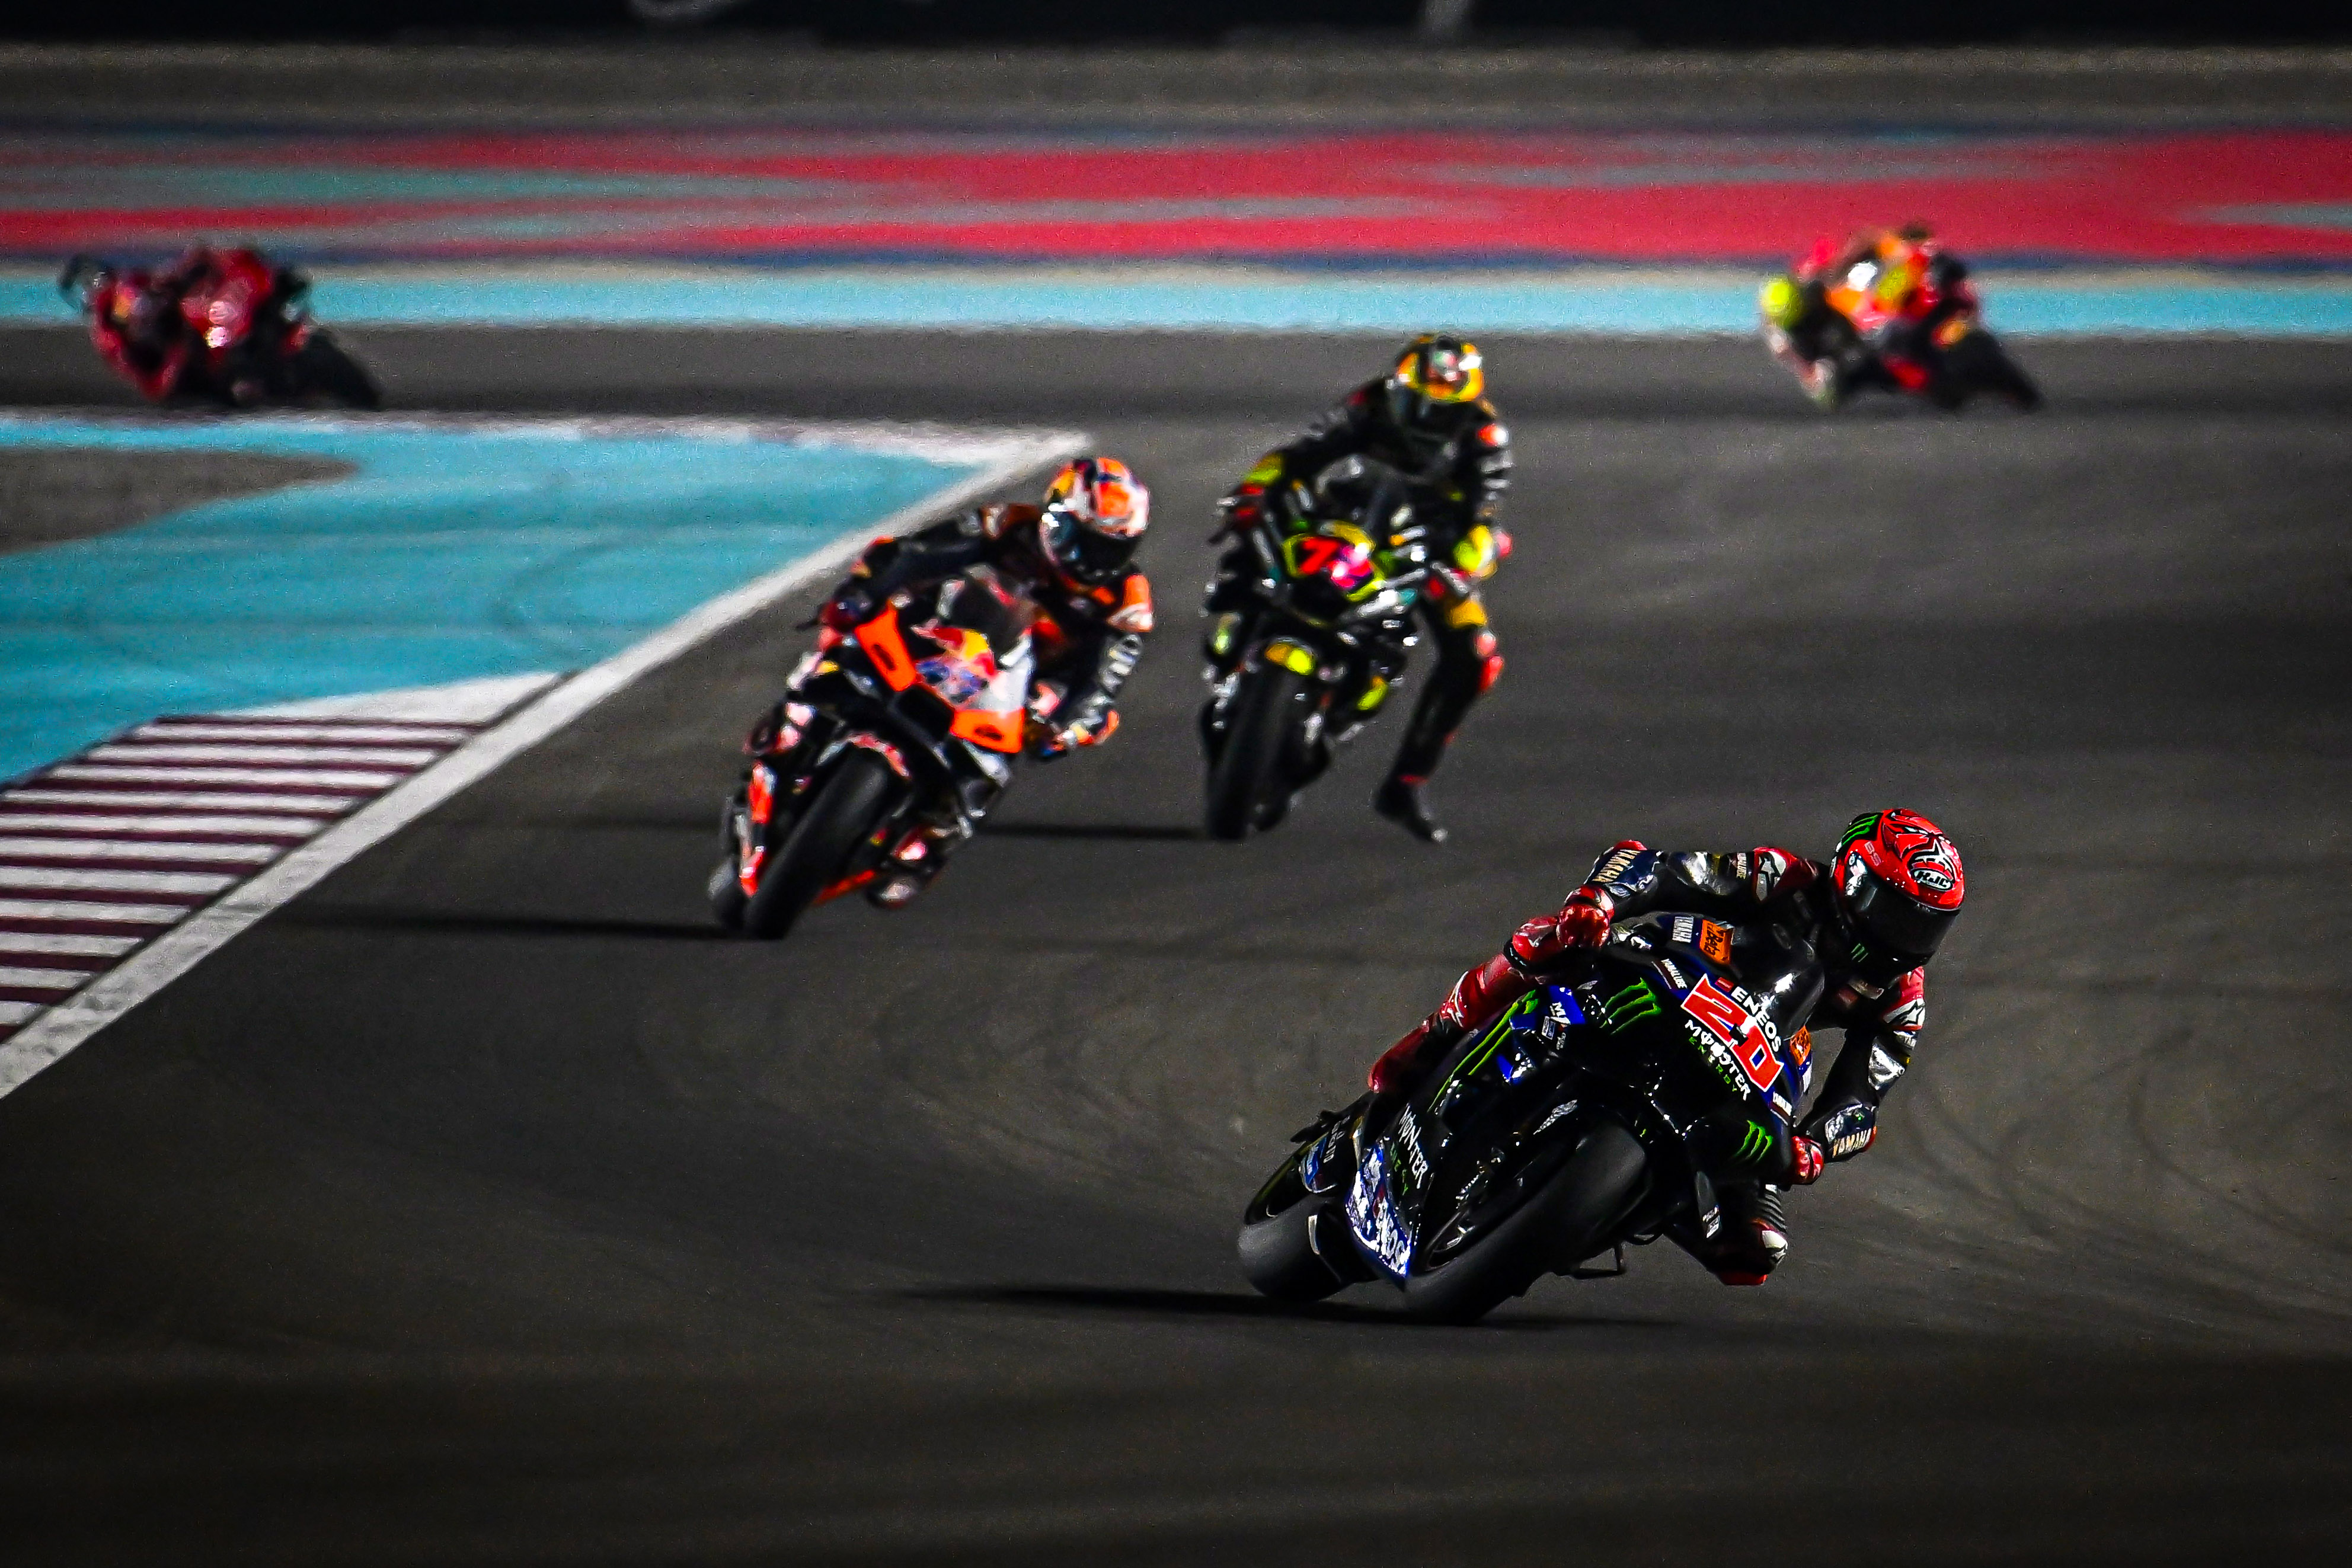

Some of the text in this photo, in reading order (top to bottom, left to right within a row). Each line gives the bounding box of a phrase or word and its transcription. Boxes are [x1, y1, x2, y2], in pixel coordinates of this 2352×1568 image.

[1298, 536, 1372, 588] 72
[1915, 871, 1948, 888] HJC
[1680, 973, 1785, 1092] 20
[1731, 986, 1782, 1052] ENEOS
[1689, 1036, 1737, 1092] ENERGY
[1397, 1102, 1429, 1189] MONTER
